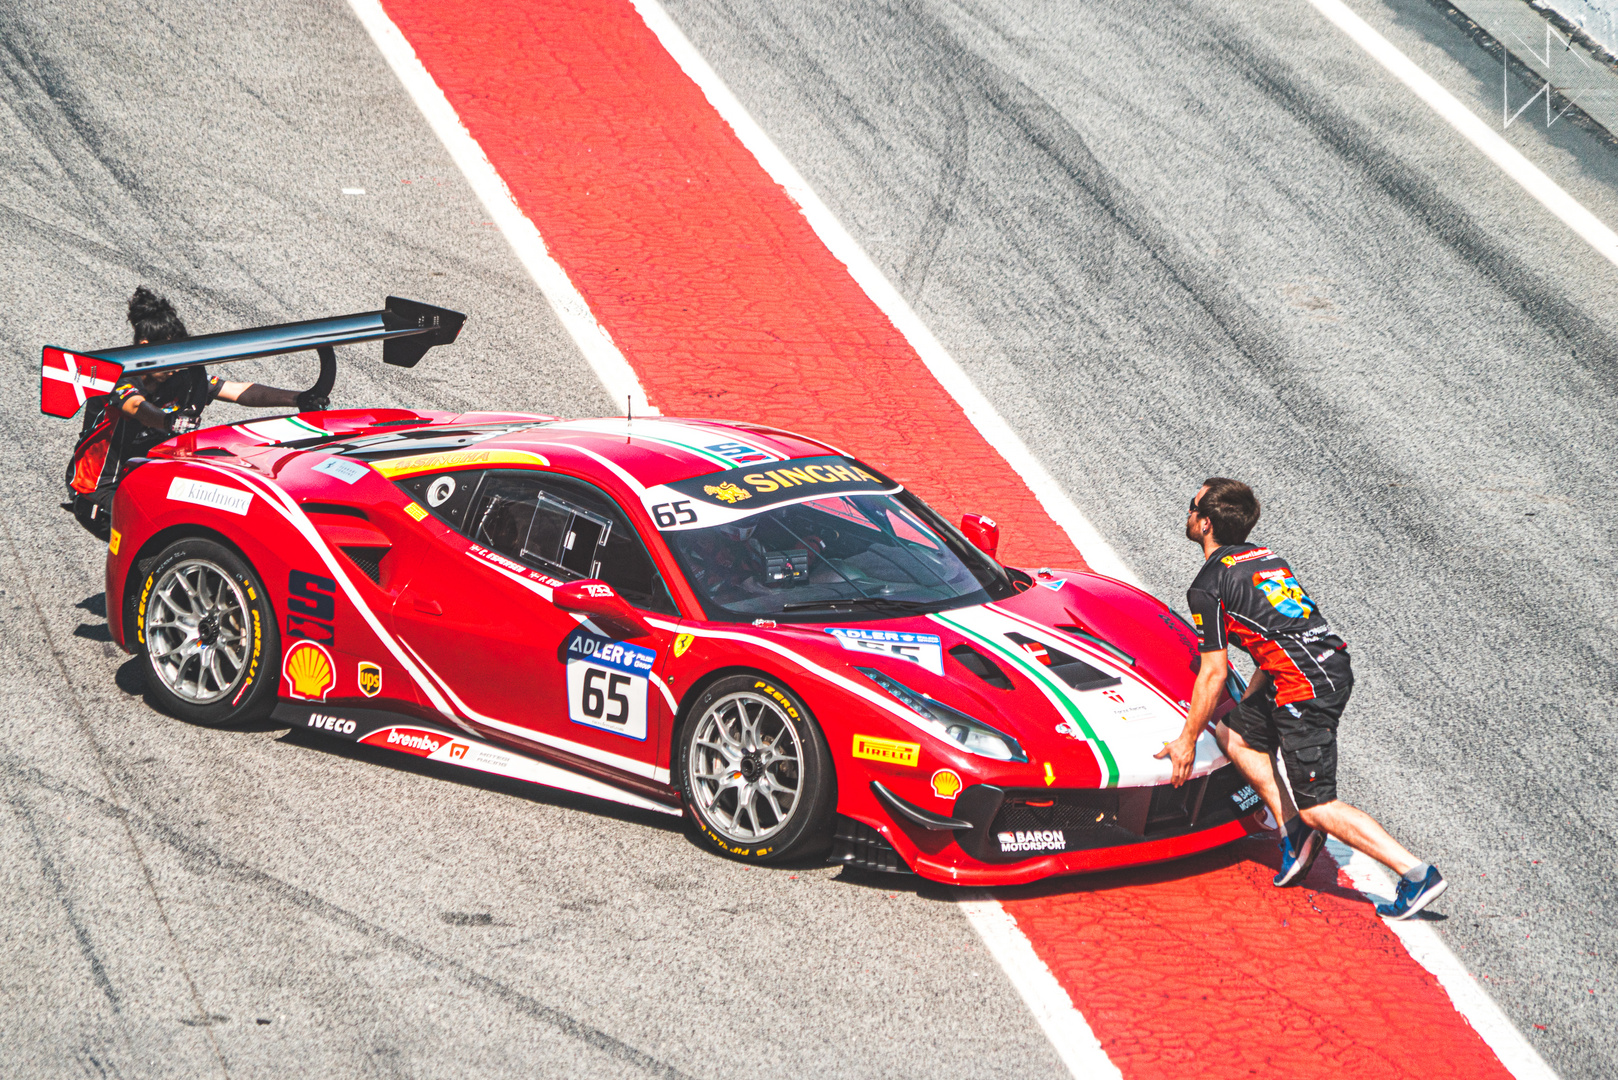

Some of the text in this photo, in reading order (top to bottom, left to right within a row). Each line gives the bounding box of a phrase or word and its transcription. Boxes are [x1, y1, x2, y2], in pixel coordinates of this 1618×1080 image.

[411, 451, 490, 468] SINGHA
[743, 464, 882, 493] SINGHA
[188, 483, 250, 512] kindmore
[651, 500, 698, 528] 65
[251, 609, 262, 678] PIRELLI
[831, 629, 899, 641] ADLER
[569, 636, 624, 664] ADLER
[360, 672, 379, 691] ups
[582, 667, 632, 725] 65
[308, 712, 356, 734] IVECO
[387, 728, 439, 752] brembo
[859, 741, 913, 761] PIRELLI
[1001, 841, 1066, 852] MOTORSPORT
[1015, 830, 1064, 843] BARON
